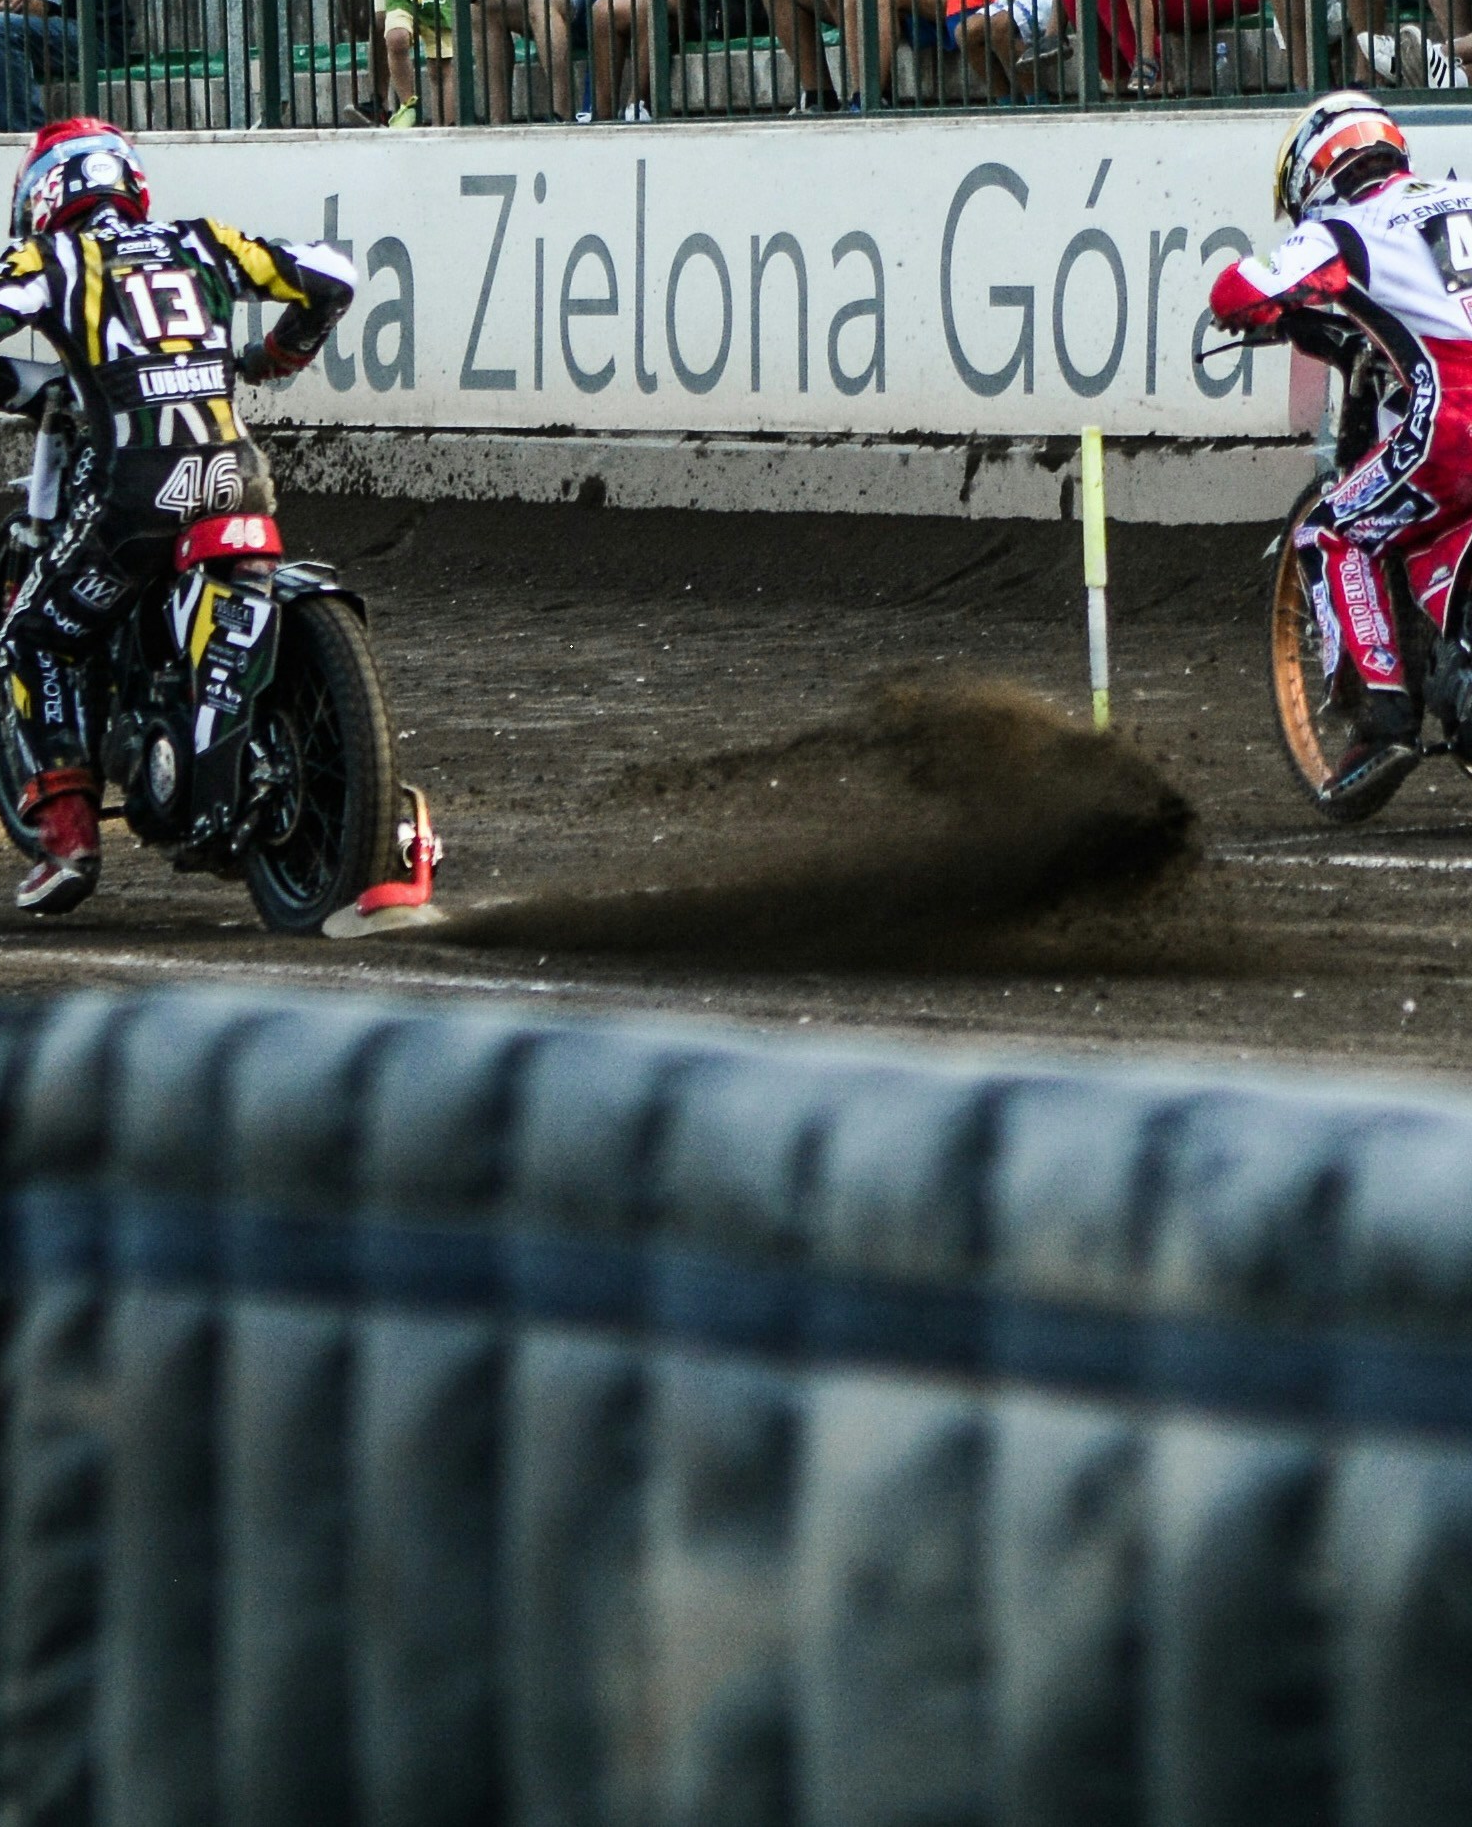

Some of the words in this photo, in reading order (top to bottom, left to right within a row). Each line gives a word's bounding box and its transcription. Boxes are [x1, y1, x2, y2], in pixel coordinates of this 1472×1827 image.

[125, 273, 206, 340] 13
[459, 159, 887, 396] Zielona
[940, 158, 1256, 400] Góra
[138, 364, 226, 398] LUBUSKIE
[155, 453, 244, 522] 46
[220, 517, 267, 549] 46
